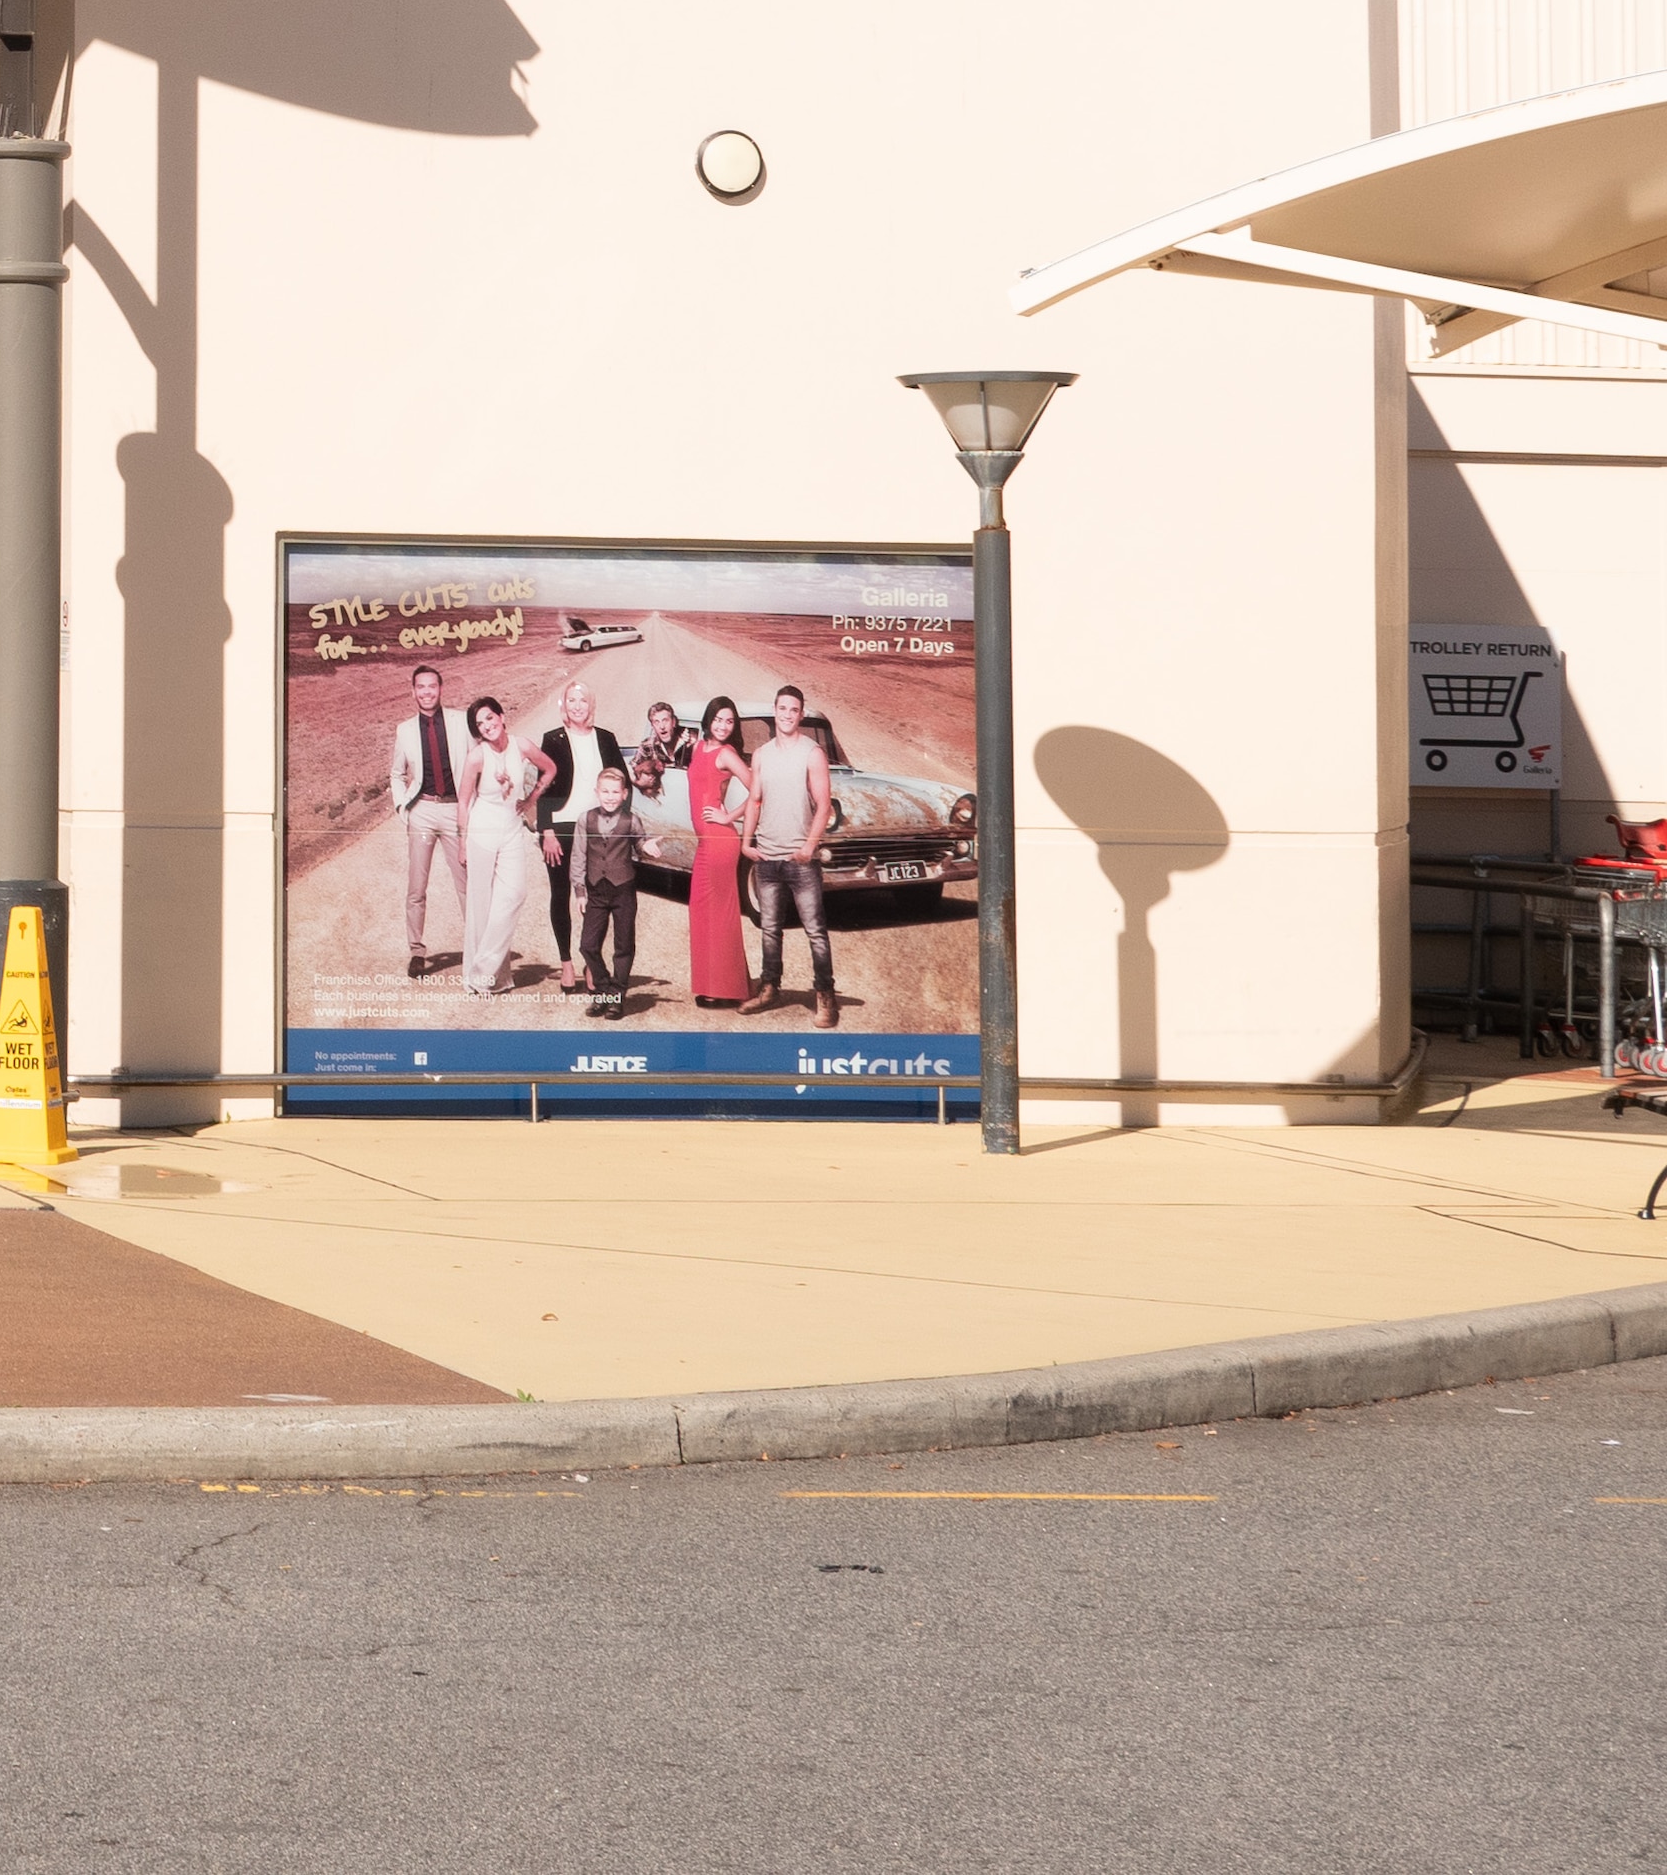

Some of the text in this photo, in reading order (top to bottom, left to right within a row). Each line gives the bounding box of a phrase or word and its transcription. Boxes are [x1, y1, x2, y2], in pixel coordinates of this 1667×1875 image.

[309, 595, 390, 629] STYLE
[488, 575, 536, 603] cuts
[862, 587, 948, 607] Galleria
[832, 614, 952, 632] Ph: 9375 7221
[840, 636, 955, 656] Open 7 Days
[1410, 641, 1551, 657] TROLLEY RETURN
[1523, 765, 1553, 774] Galleria
[314, 974, 372, 986] Franchise
[416, 975, 445, 986] 1800
[314, 992, 622, 1007] Each business is independently owned and operated
[314, 1007, 430, 1019] www.justcuts.com
[5, 1042, 33, 1055] WET
[315, 1052, 327, 1061] No
[570, 1055, 648, 1072] JUSTICE
[315, 1063, 334, 1072] Just
